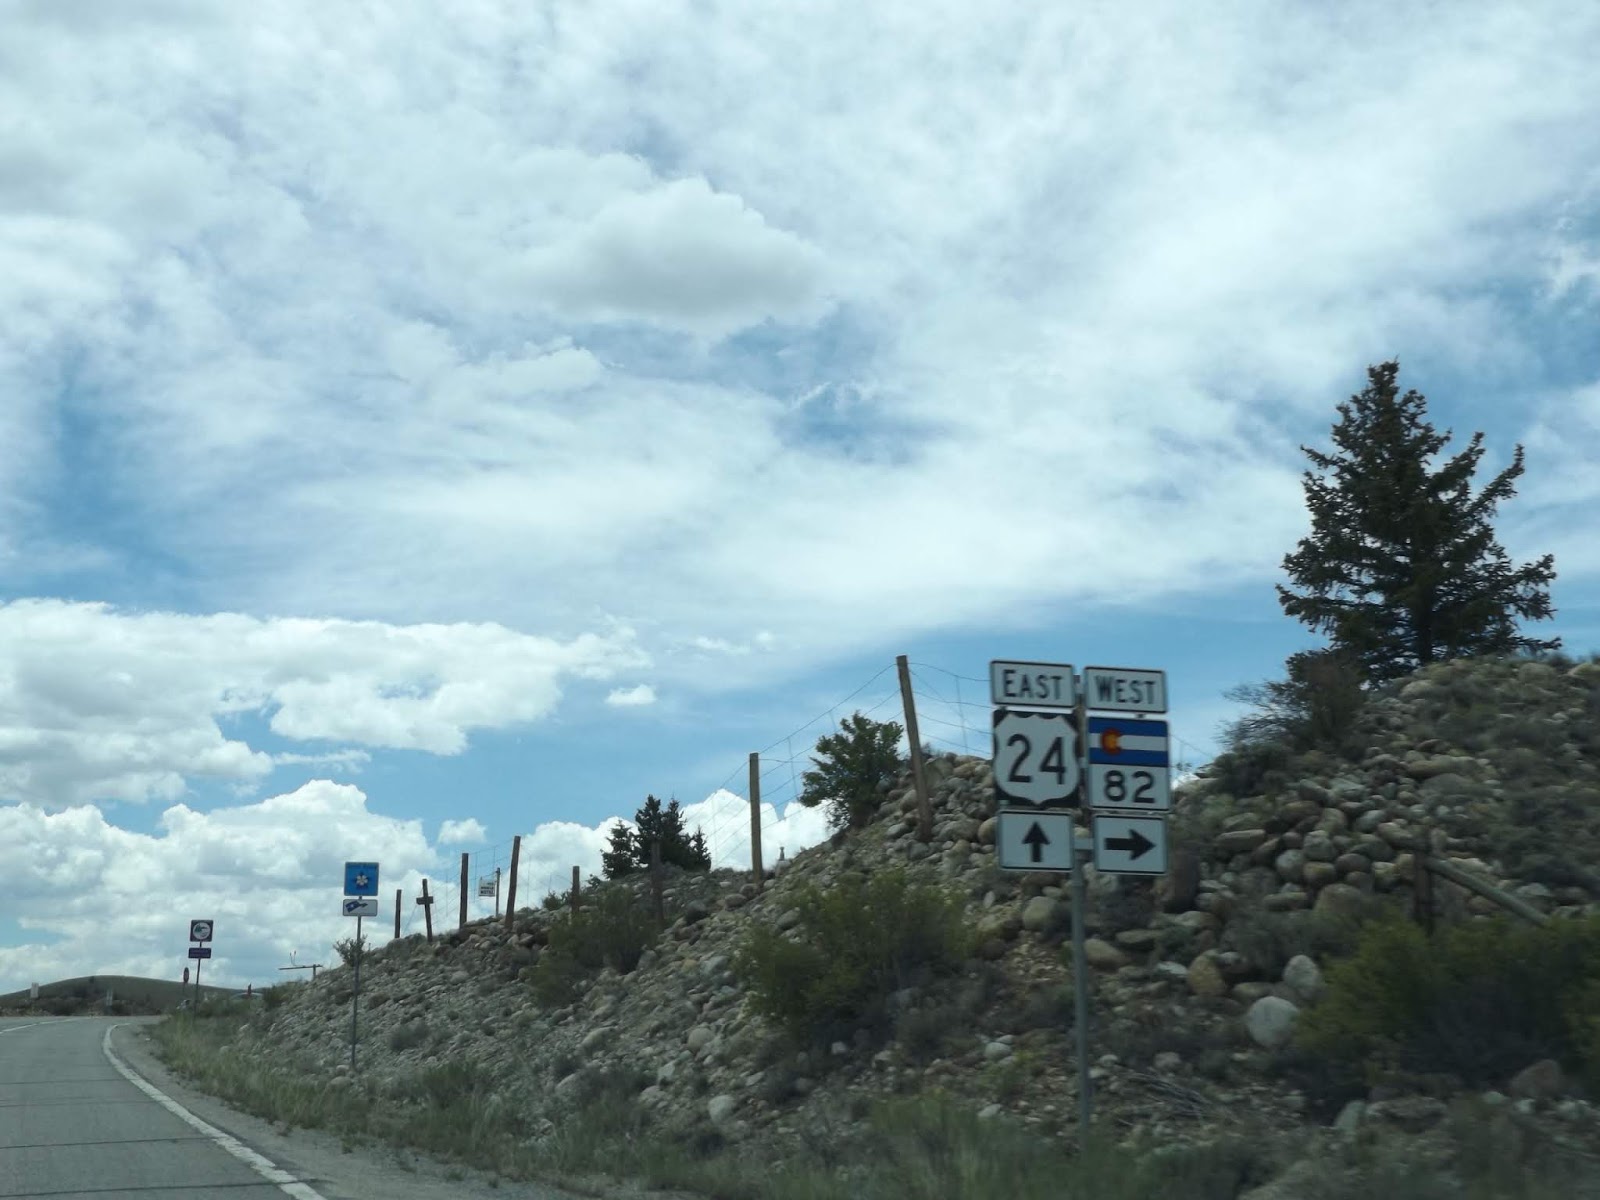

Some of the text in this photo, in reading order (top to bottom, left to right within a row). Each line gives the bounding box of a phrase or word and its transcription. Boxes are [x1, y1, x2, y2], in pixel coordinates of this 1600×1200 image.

[1003, 669, 1063, 699] EAST
[1095, 676, 1155, 704] WEST
[1006, 734, 1066, 785] 24
[1104, 770, 1155, 803] 82
